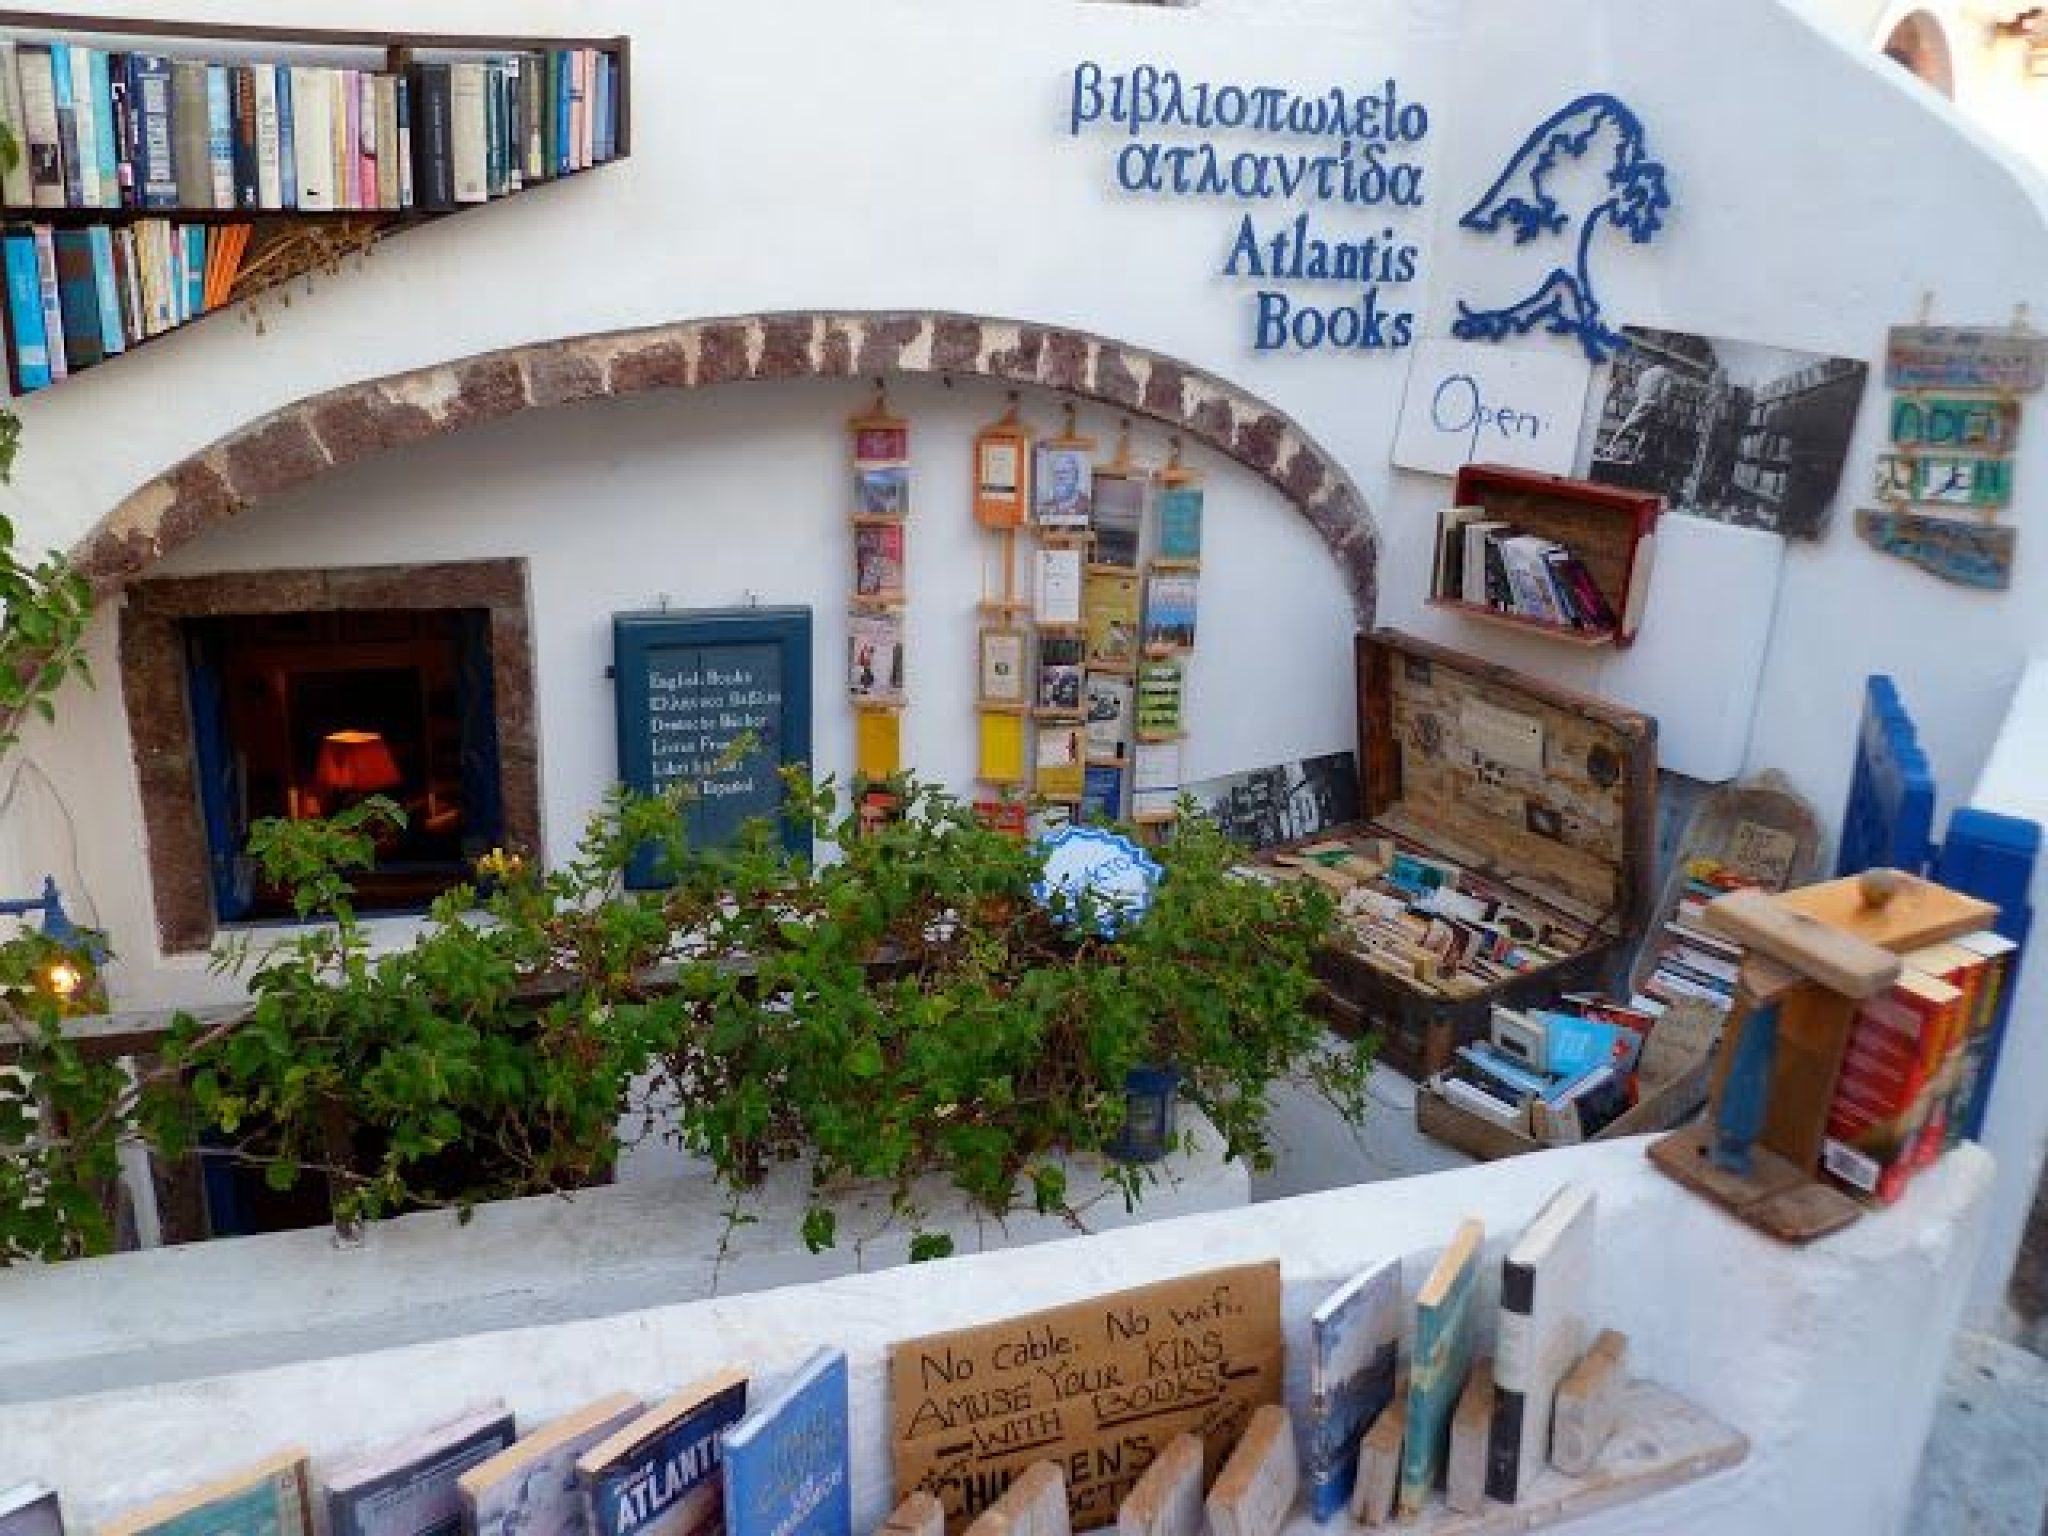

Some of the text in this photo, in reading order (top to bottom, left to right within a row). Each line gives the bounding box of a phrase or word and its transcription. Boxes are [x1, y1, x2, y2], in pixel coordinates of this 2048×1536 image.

[1222, 213, 1418, 283] Atlantis
[1253, 289, 1413, 350] Books
[921, 1346, 975, 1391] No
[1105, 1305, 1151, 1342] No
[902, 1381, 1033, 1441] AMUSE
[1145, 1330, 1225, 1378] KIDS
[972, 1408, 1063, 1451] WITH
